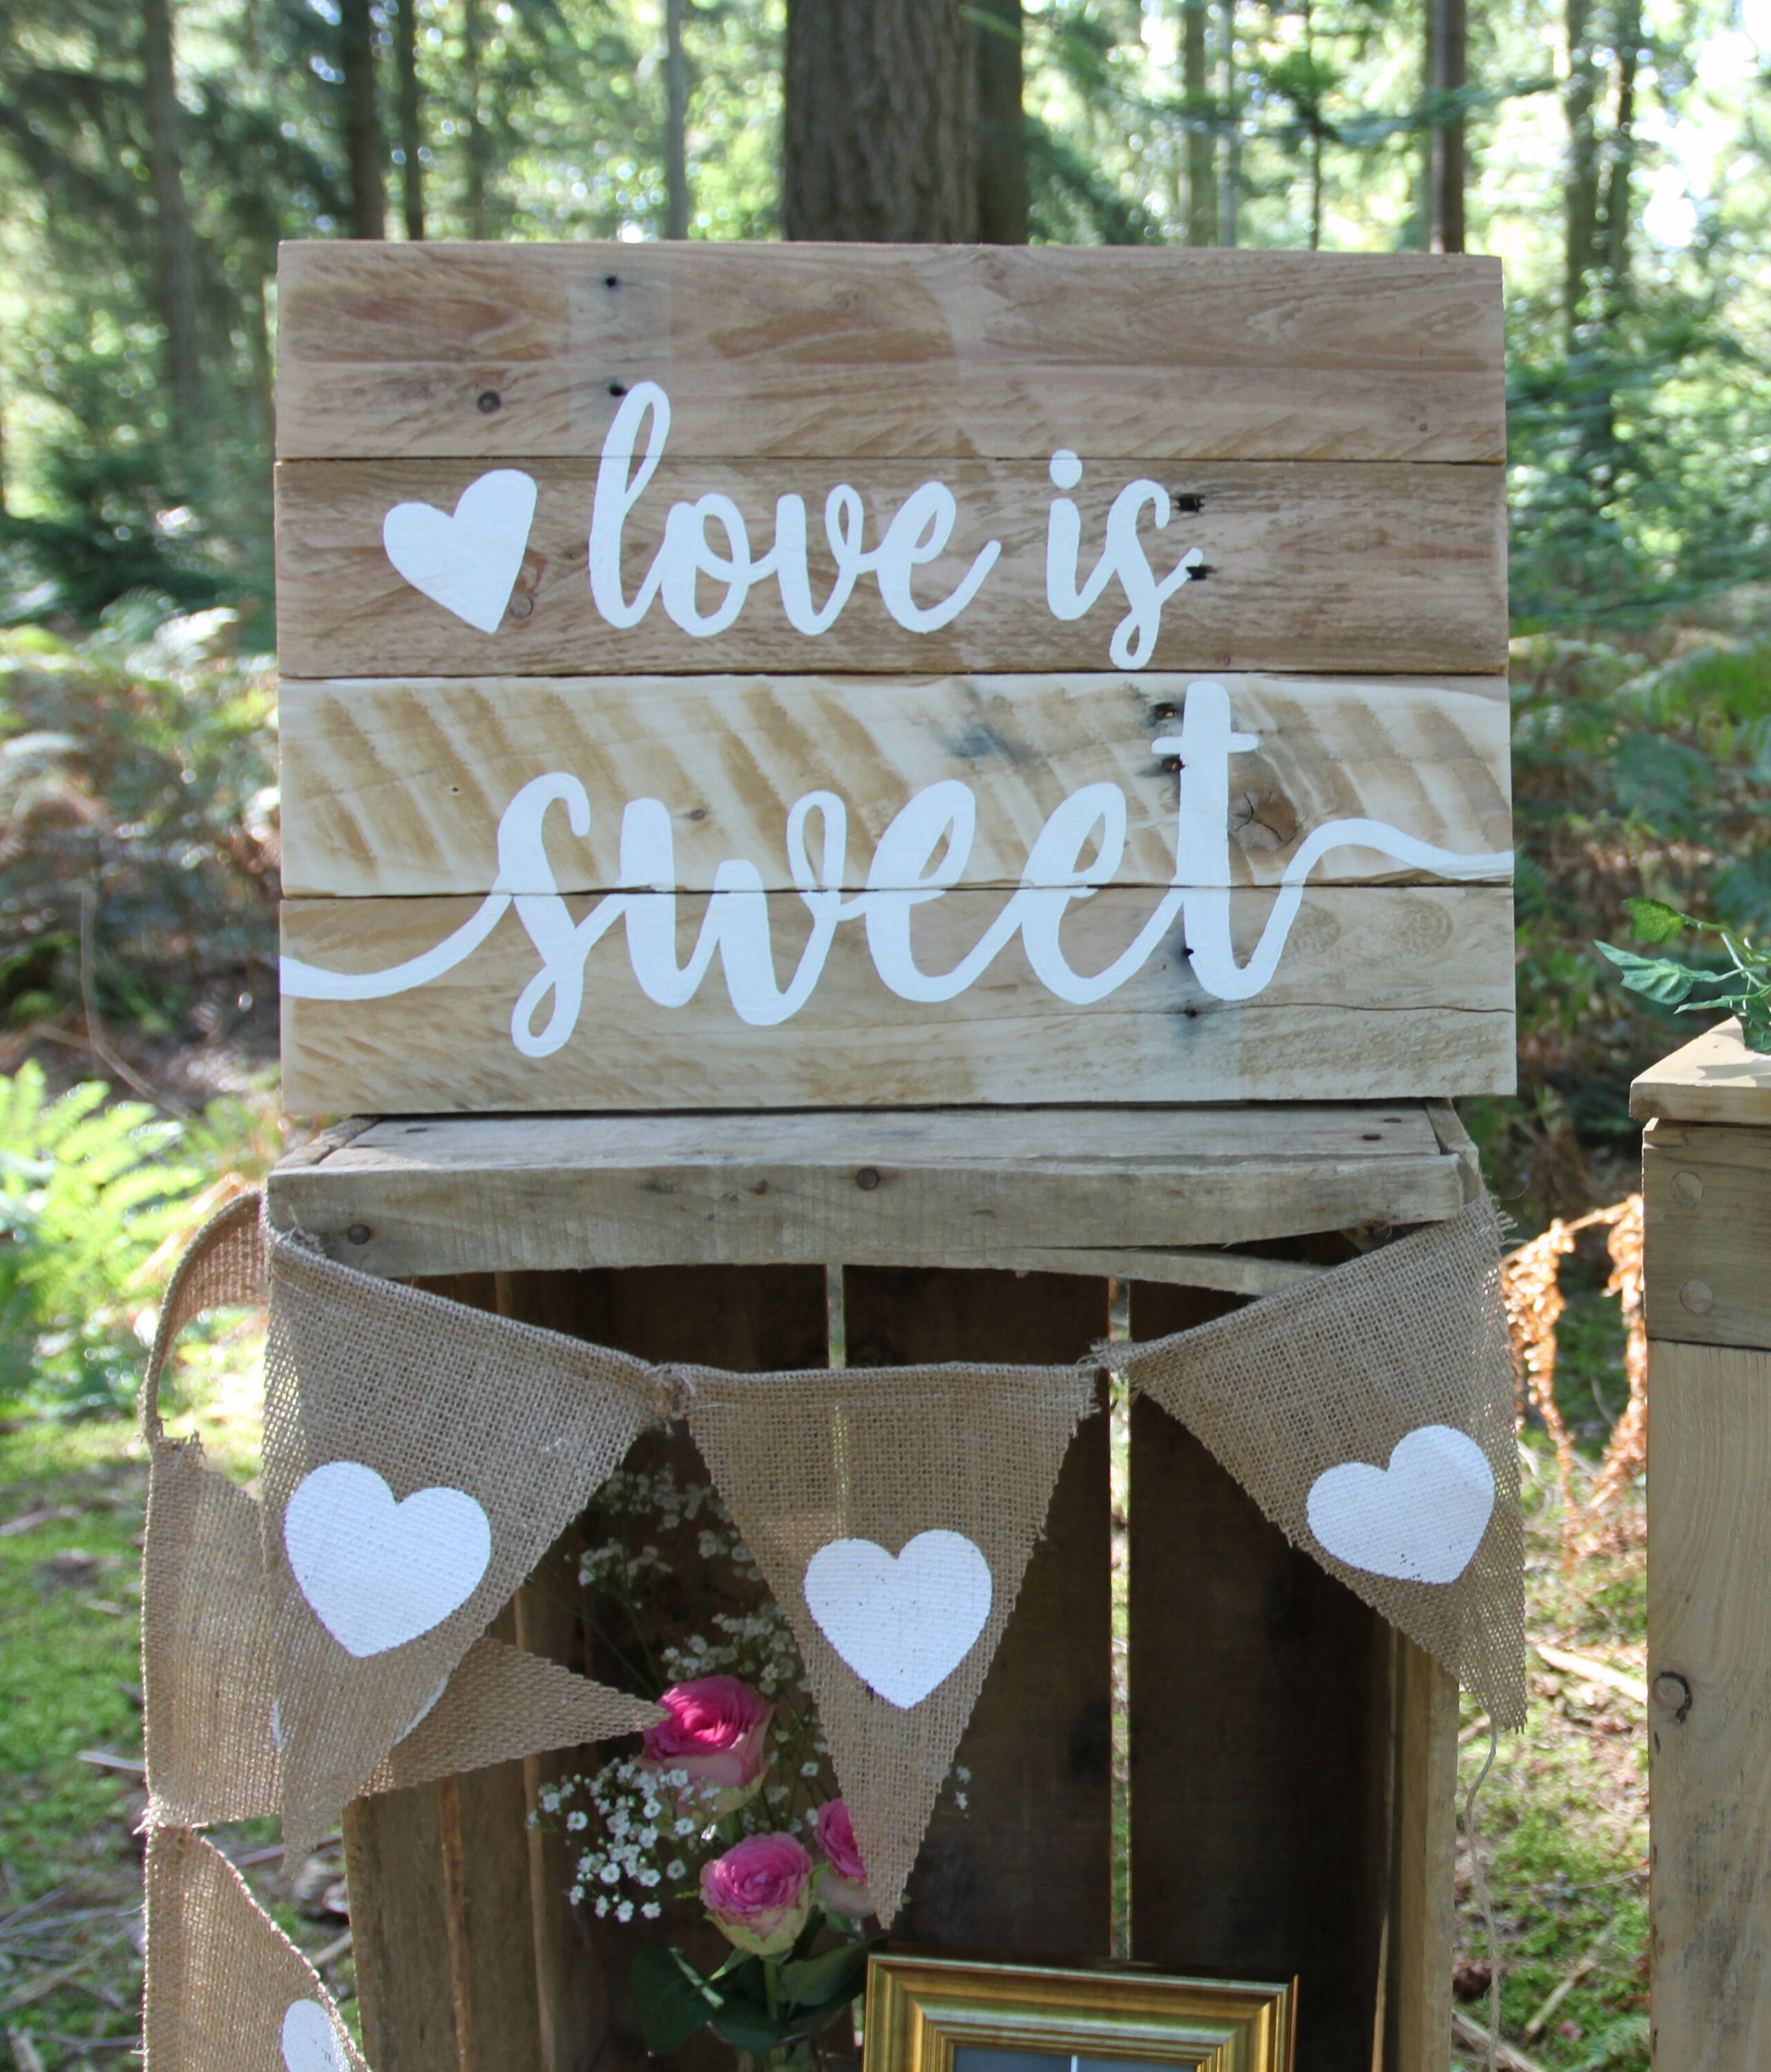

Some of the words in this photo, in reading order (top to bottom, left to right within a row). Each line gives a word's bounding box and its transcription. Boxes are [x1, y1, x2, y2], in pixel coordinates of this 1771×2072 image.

[588, 381, 1002, 637] love
[1046, 449, 1203, 670] is
[279, 681, 1514, 1058] sweet
